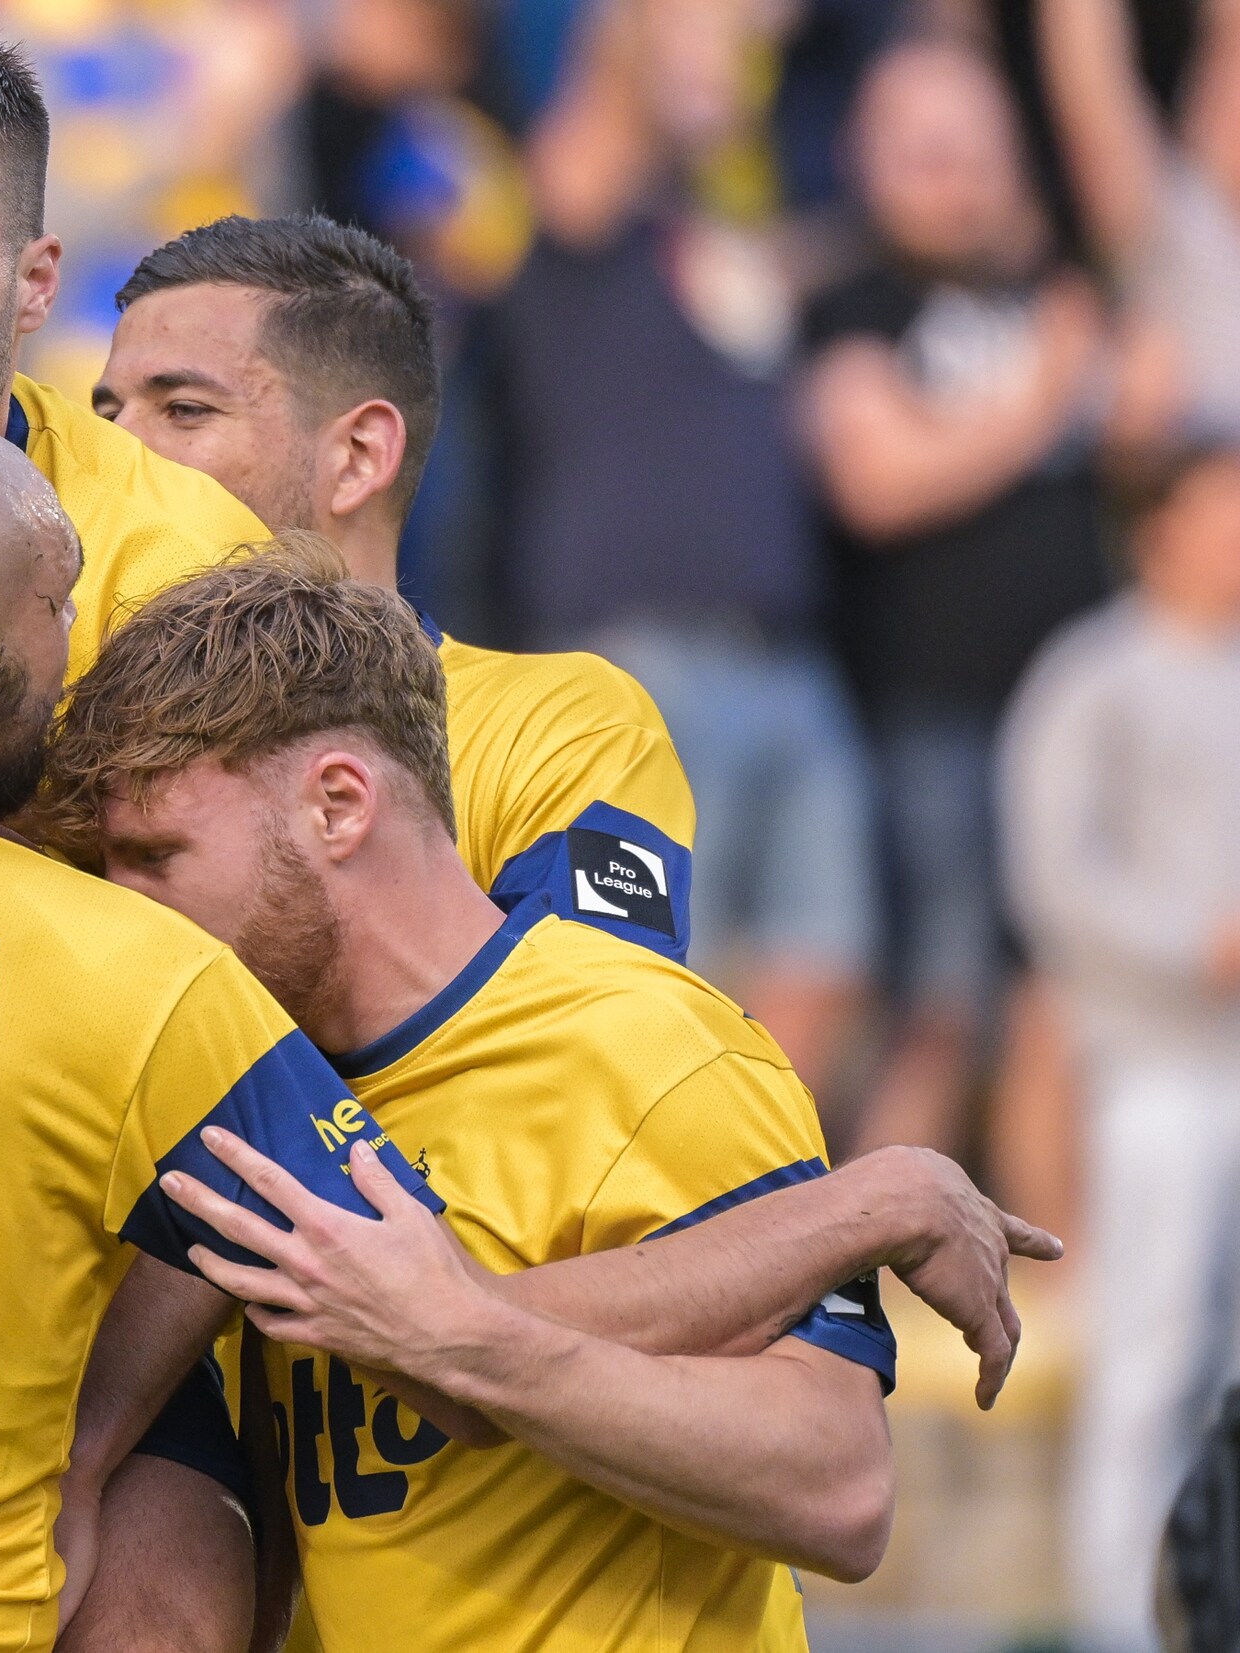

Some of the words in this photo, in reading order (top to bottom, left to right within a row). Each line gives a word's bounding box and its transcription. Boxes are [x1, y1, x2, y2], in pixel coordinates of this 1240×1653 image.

[609, 860, 637, 879] Pro
[594, 871, 653, 898] League
[273, 1355, 453, 1526] tto
